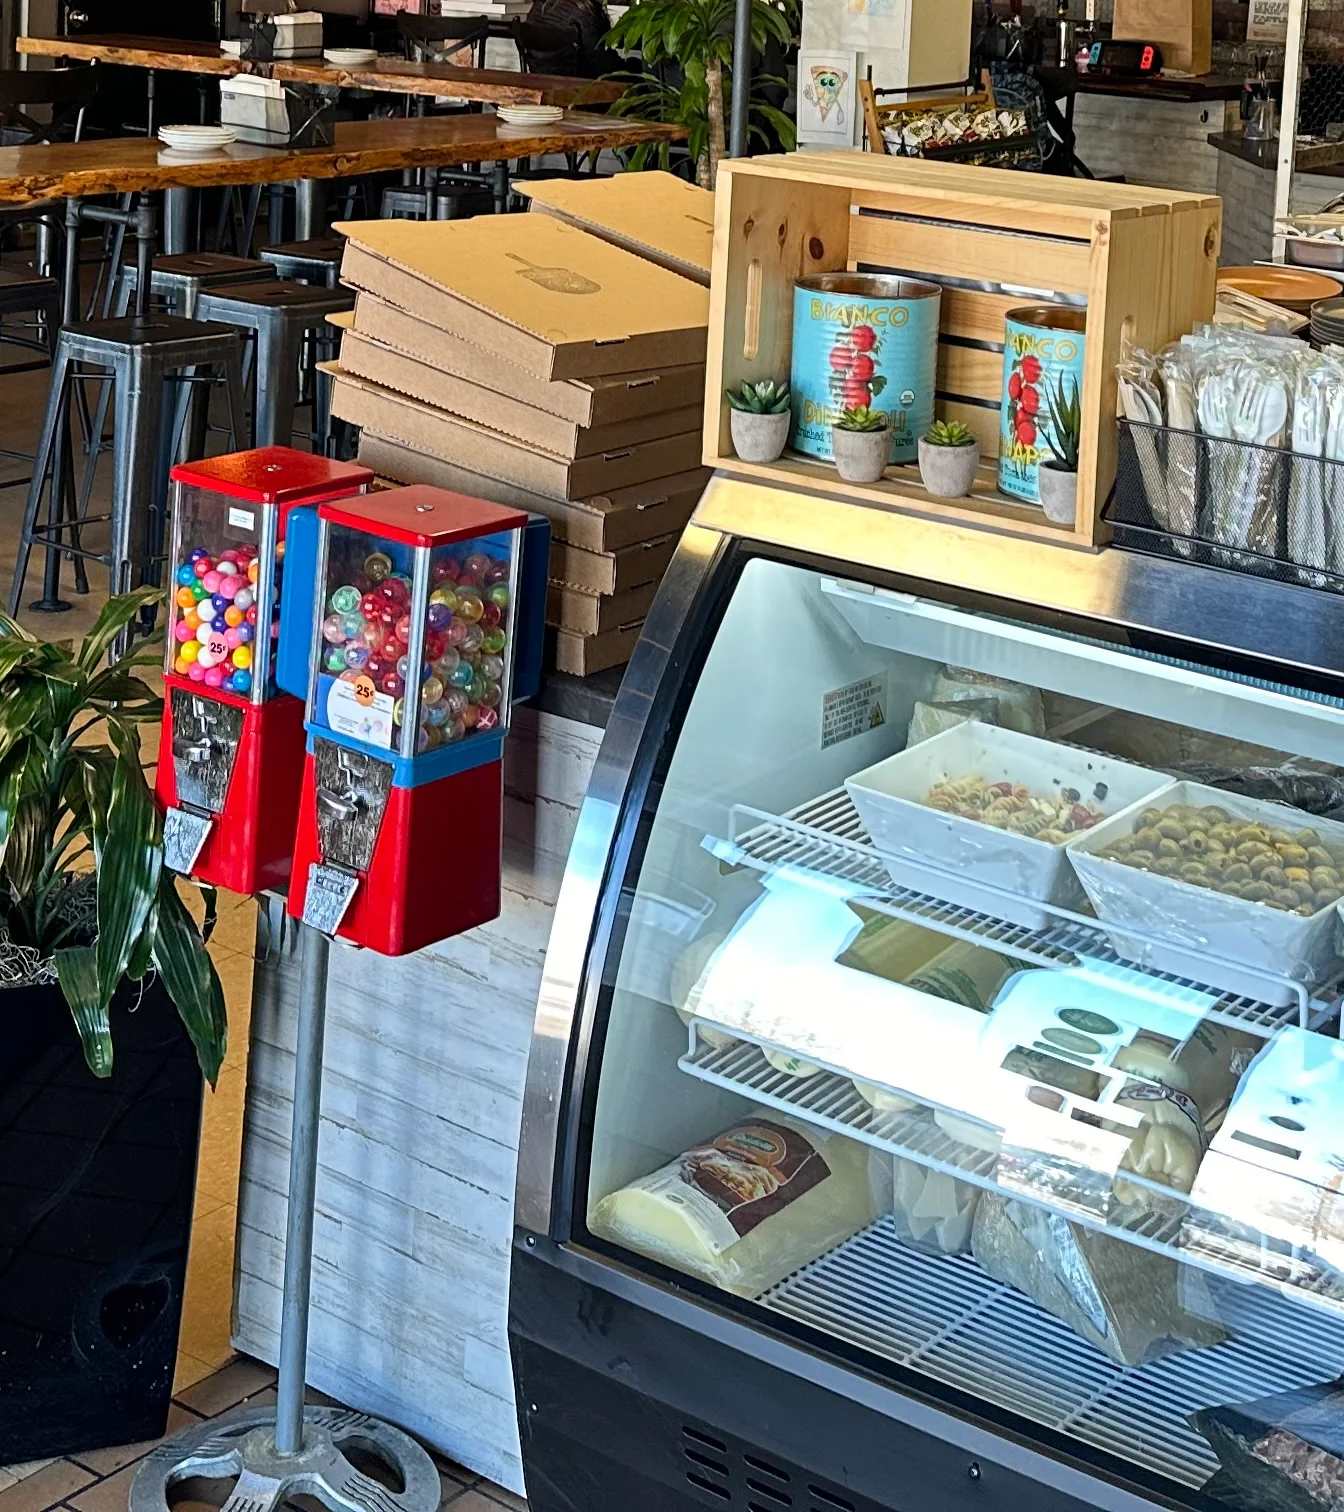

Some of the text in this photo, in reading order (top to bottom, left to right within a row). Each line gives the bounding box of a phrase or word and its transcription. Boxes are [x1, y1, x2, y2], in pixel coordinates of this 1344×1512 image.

[810, 298, 909, 327] BIANCO
[210, 642, 226, 655] 25¢
[356, 683, 374, 698] 25¢
